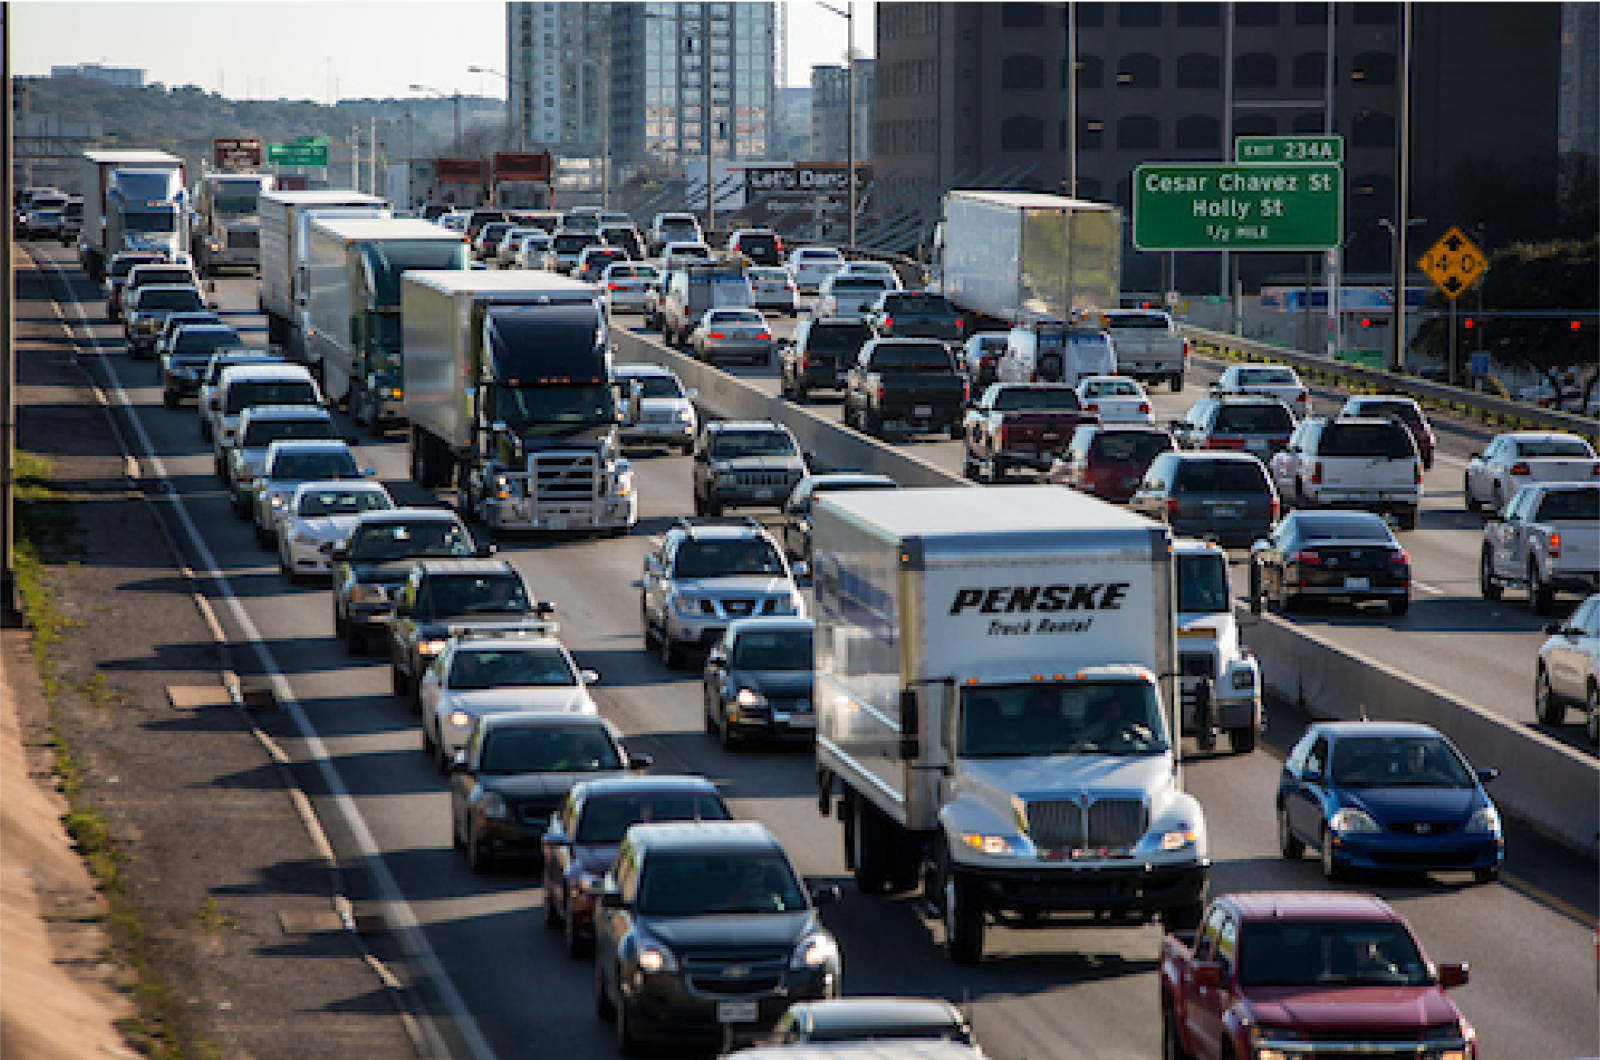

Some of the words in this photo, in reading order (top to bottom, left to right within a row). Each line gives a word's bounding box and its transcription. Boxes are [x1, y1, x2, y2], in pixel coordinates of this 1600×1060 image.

[1283, 142, 1332, 159] 234A
[1145, 173, 1207, 192] Cesar
[1219, 173, 1299, 192] Chavez
[1308, 173, 1332, 191] St
[1193, 197, 1250, 221] Holly
[1260, 197, 1284, 217] St
[948, 583, 1132, 616] PENSKE
[986, 619, 1030, 637] Truck
[1034, 617, 1094, 635] Rental
